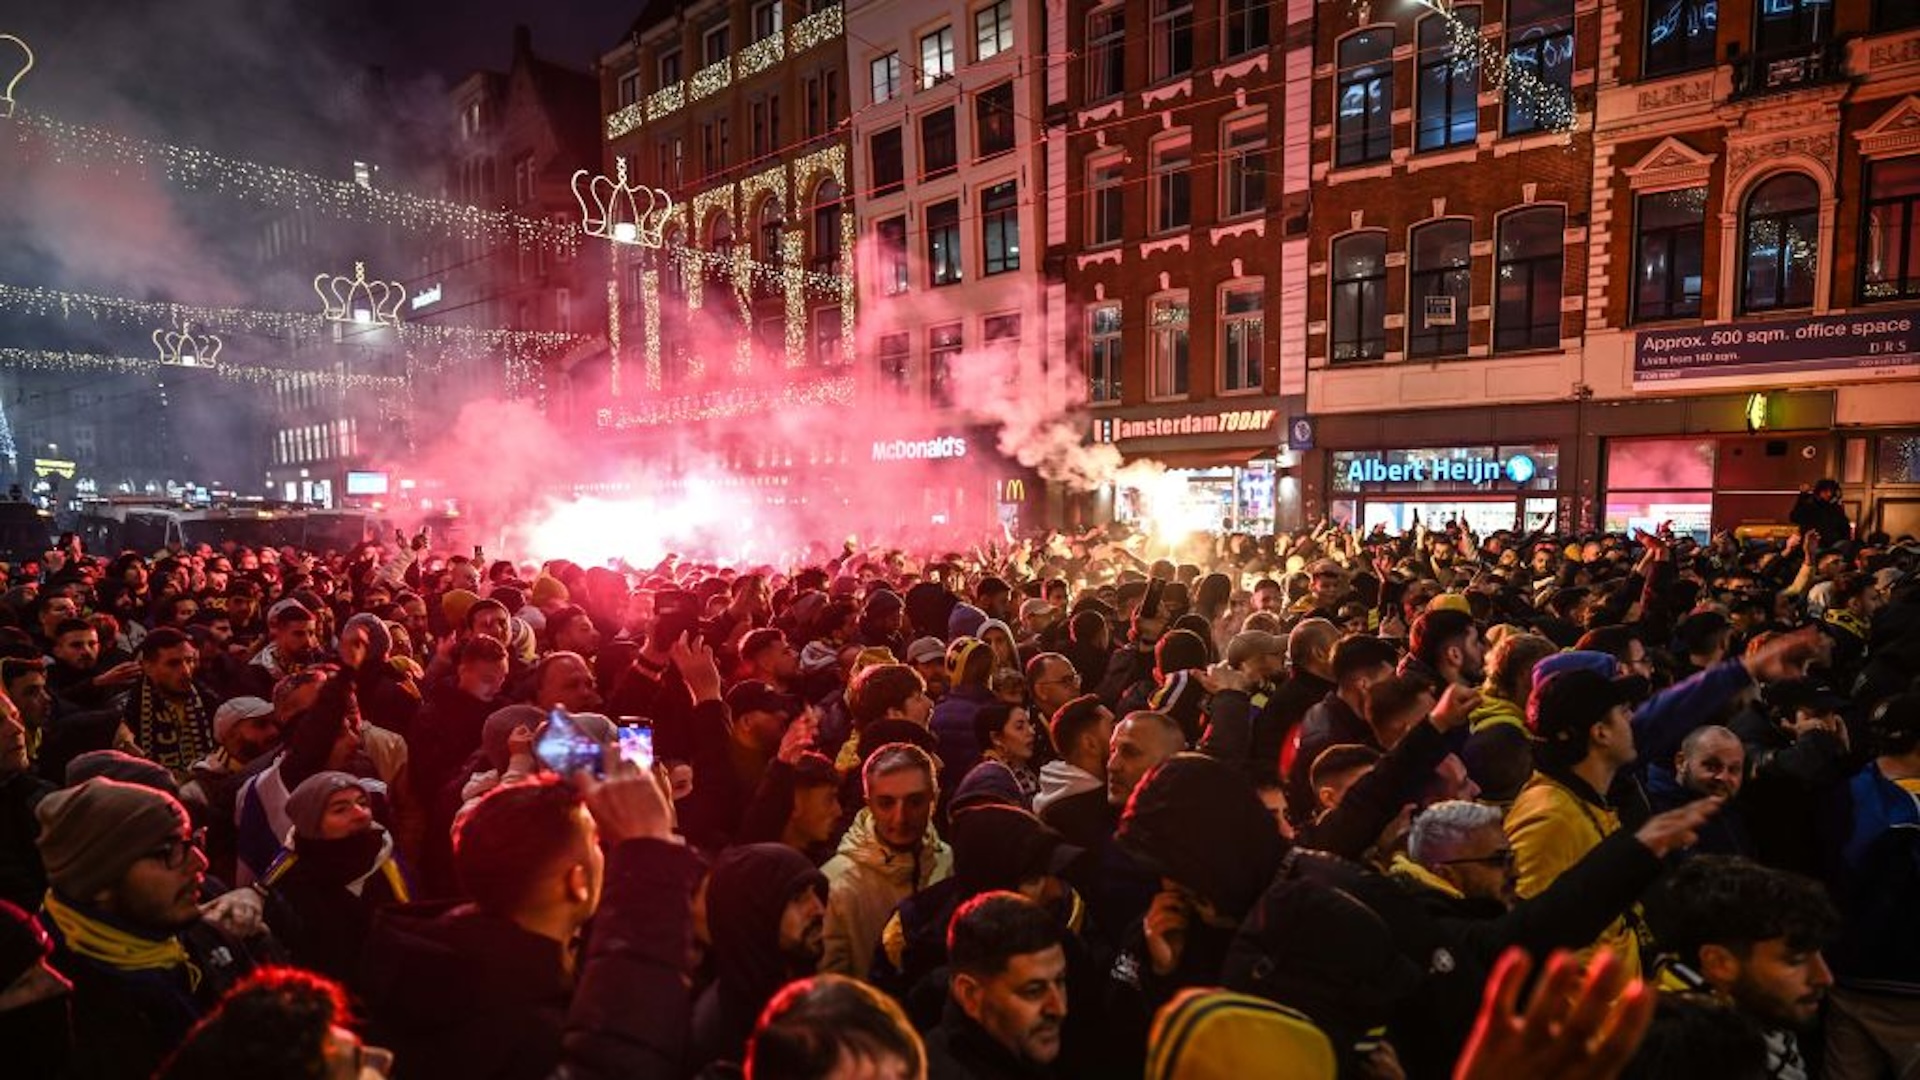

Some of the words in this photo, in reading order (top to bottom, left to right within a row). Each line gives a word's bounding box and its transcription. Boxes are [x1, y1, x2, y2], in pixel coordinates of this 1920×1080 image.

[1642, 336, 1706, 351] Approx.
[1711, 330, 1742, 346] 500
[1747, 329, 1790, 344] sqm.
[1795, 323, 1847, 339] office
[1851, 319, 1912, 336] space
[872, 436, 967, 461] McDonald's
[1348, 458, 1424, 481] Albert
[1432, 457, 1500, 485] Heijn
